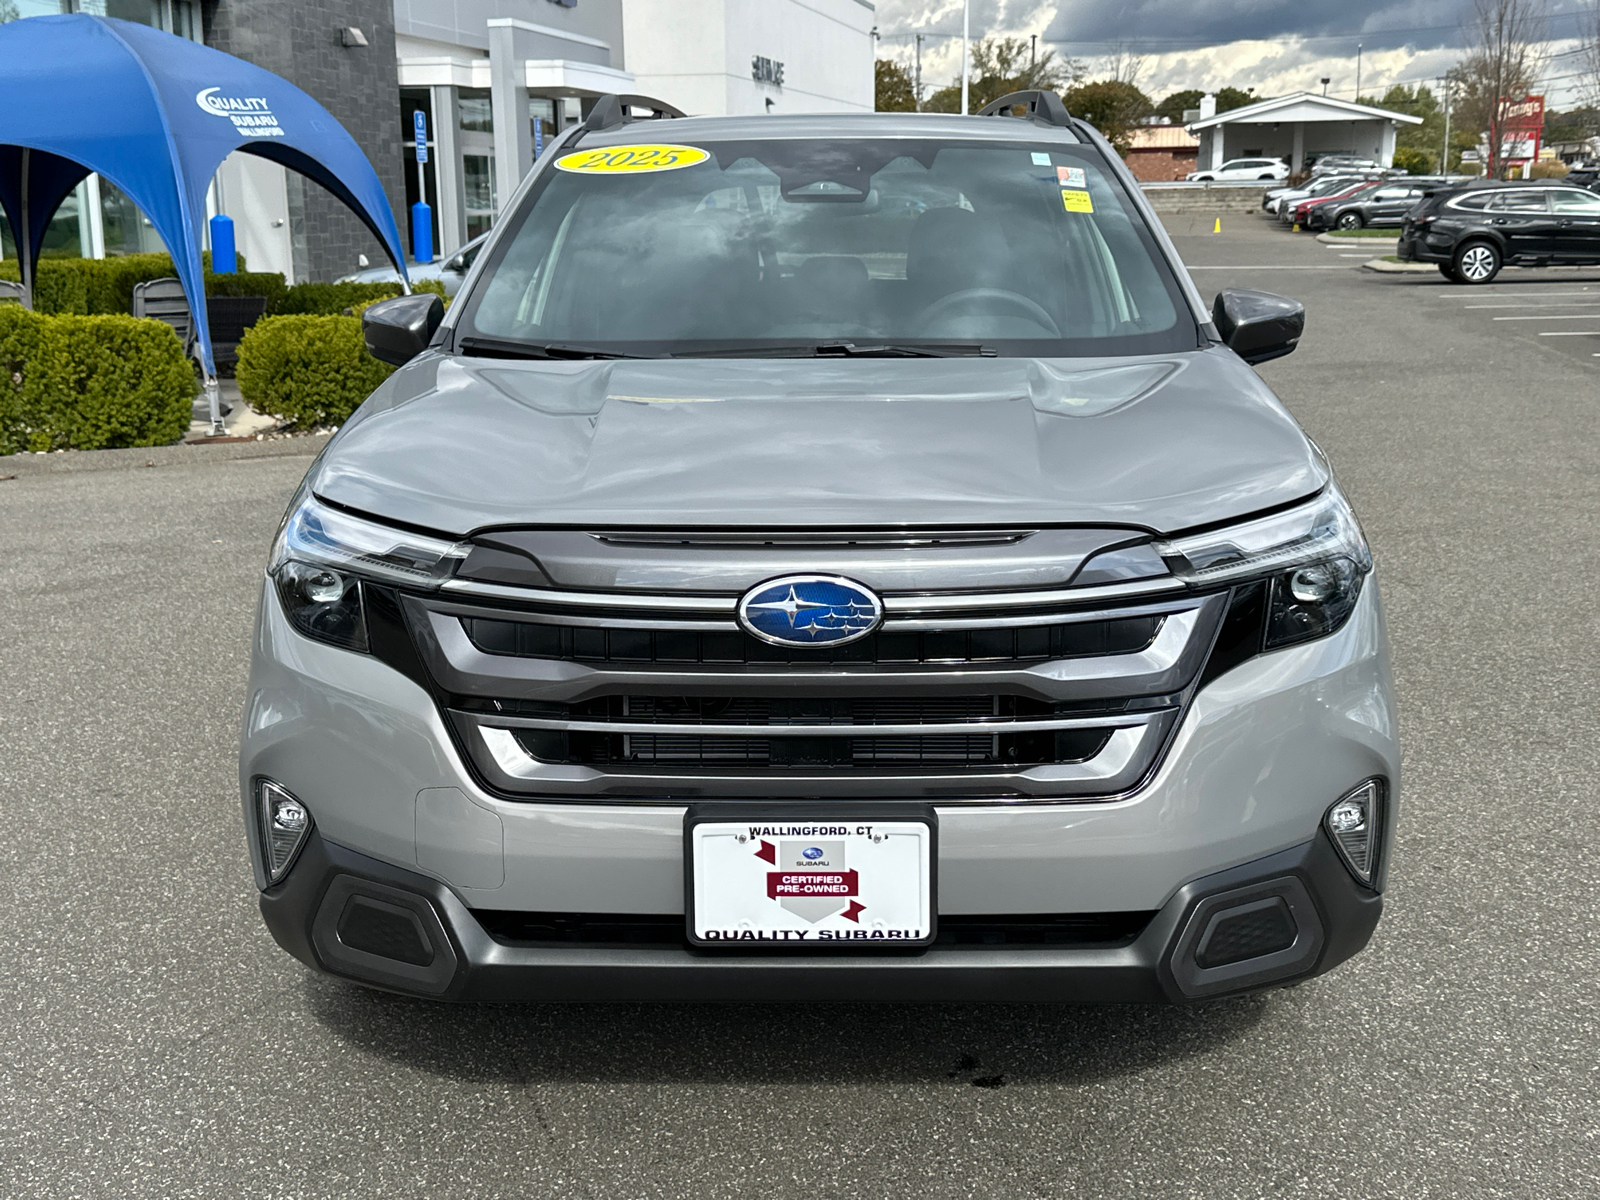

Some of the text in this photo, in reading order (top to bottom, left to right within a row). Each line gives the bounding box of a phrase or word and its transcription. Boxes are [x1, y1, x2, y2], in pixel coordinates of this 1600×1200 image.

[207, 96, 269, 110] QUALITY
[229, 115, 279, 127] SUBARU
[236, 127, 285, 137] WALLINGFORD
[578, 149, 687, 169] 2025
[856, 826, 873, 836] CT
[782, 875, 843, 884] CERTIFIED
[776, 884, 849, 893] PRE-OWNED
[704, 929, 920, 941] QUALITY SUBARU
